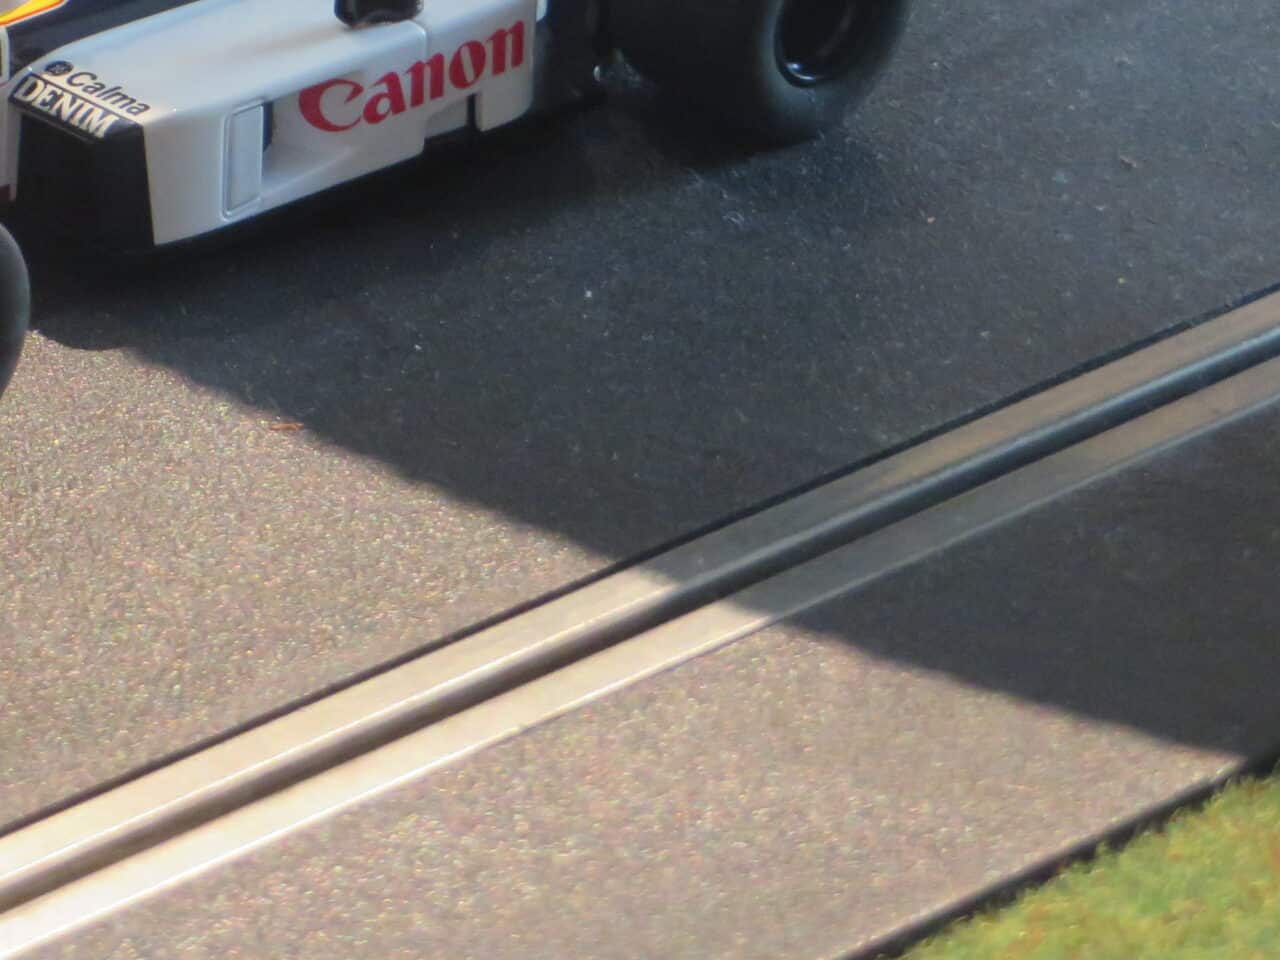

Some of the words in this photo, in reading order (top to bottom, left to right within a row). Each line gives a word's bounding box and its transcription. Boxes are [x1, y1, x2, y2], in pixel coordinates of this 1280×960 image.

[14, 75, 121, 139] DENIM
[66, 71, 152, 116] Calma
[298, 20, 526, 133] Canon
